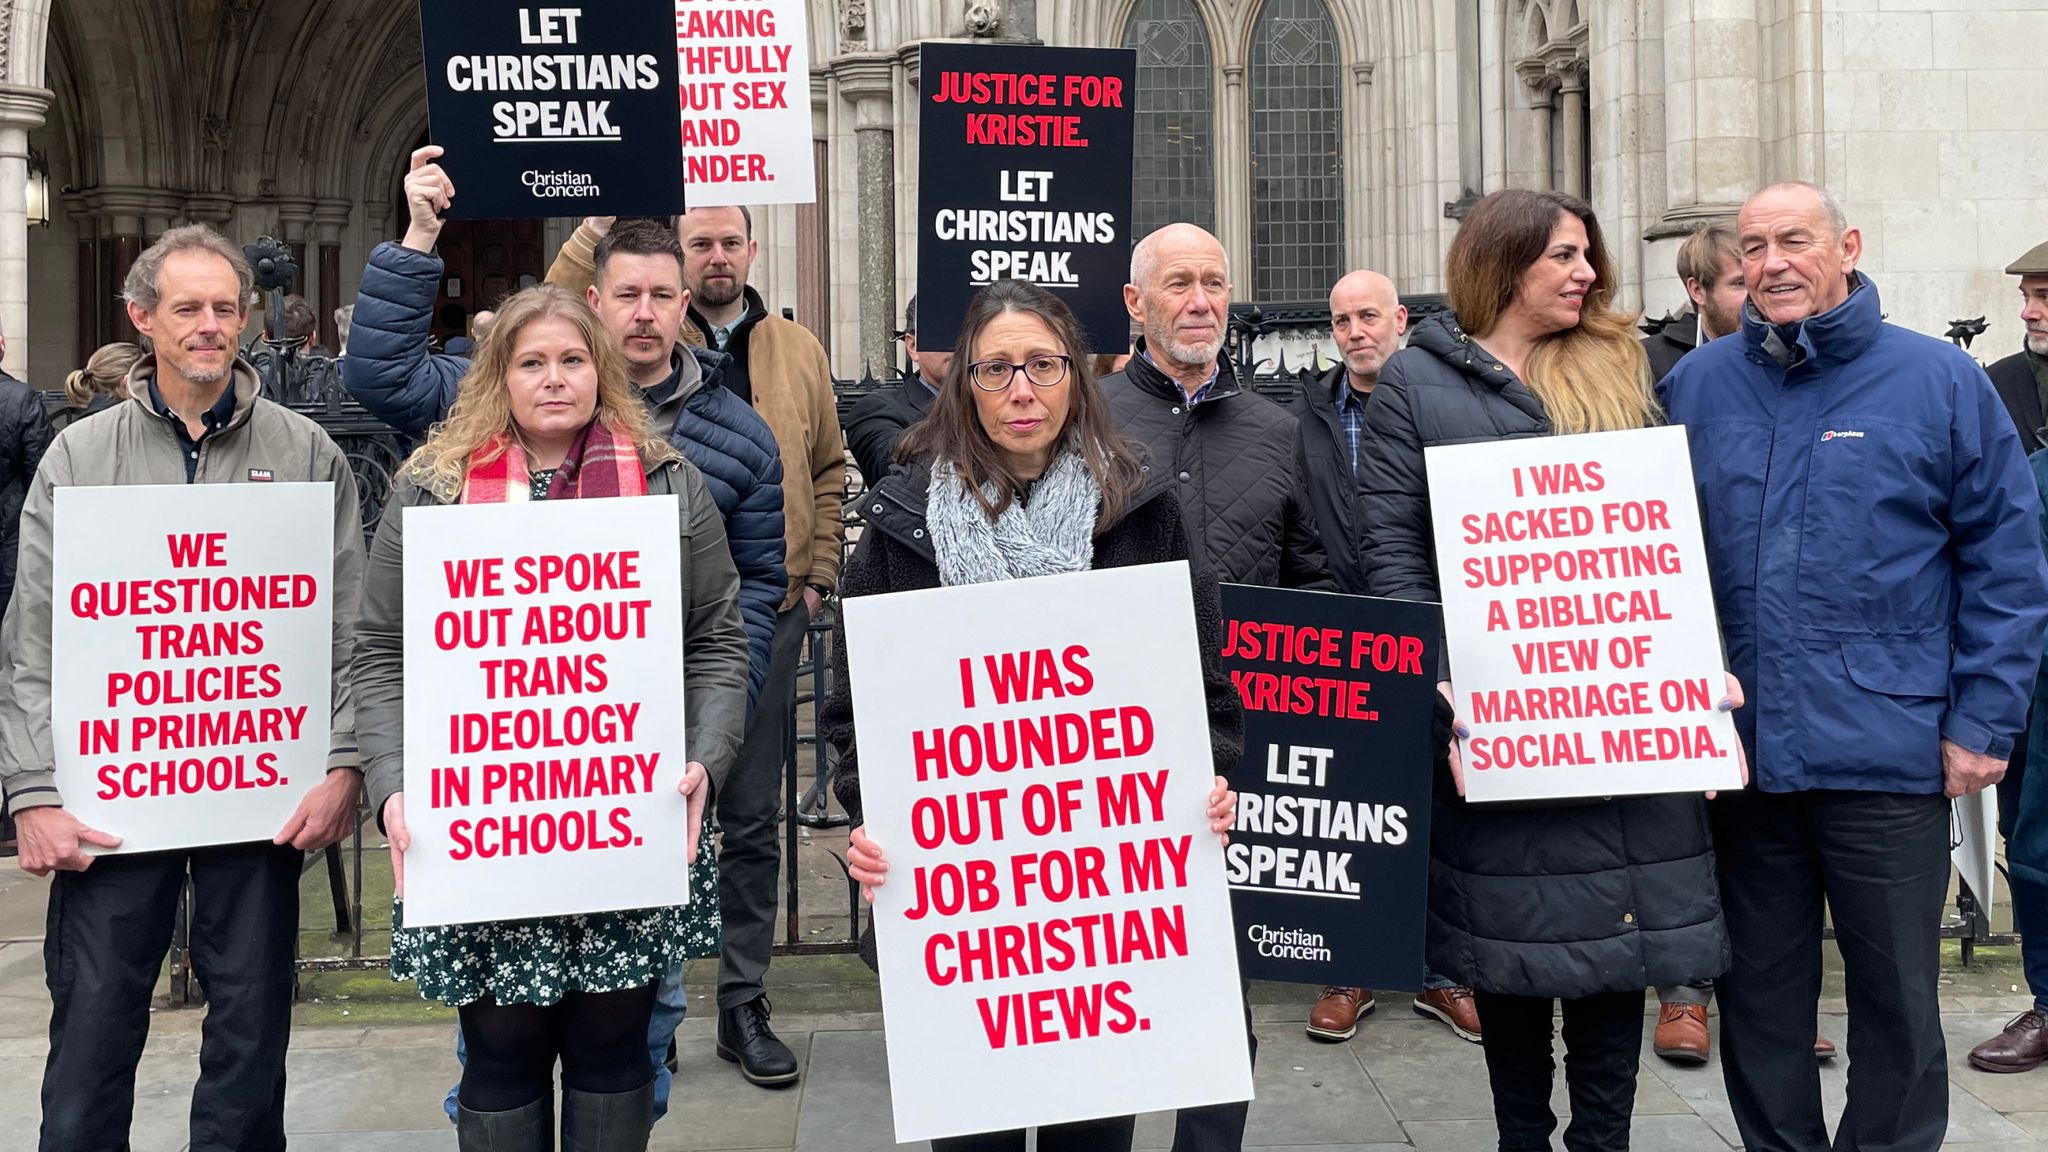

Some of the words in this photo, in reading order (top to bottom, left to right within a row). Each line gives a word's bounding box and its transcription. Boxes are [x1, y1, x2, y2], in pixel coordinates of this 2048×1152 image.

[519, 9, 581, 43] LET
[447, 55, 659, 91] CHRISTIANS
[933, 72, 1056, 105] JUSTICE
[1064, 76, 1122, 107] FOR
[733, 82, 786, 110] SEX
[492, 100, 621, 137] SPEAK.
[682, 119, 740, 147] AND
[967, 113, 1088, 146] KRISTIE.
[521, 170, 592, 187] Christian
[532, 181, 600, 198] Concern
[684, 154, 774, 183] NDER.
[1000, 171, 1053, 202] LET
[936, 209, 1114, 243] CHRISTIANS
[969, 249, 1079, 283] SPEAK.
[1512, 469, 1522, 496] I
[1531, 462, 1604, 495] WAS
[1463, 507, 1593, 544] SACKED
[1603, 500, 1669, 532] FOR
[168, 533, 226, 568] WE
[1464, 544, 1680, 587] SUPPORTING
[444, 558, 504, 598] WE
[515, 551, 640, 595] SPOKE
[71, 575, 316, 620] QUESTIONED
[1488, 601, 1509, 630] A
[1517, 590, 1671, 628] BIBLICAL
[136, 621, 263, 659] TRANS
[435, 608, 512, 650] OUT
[523, 600, 651, 645] ABOUT
[1351, 632, 1423, 674] FOR
[1513, 640, 1598, 674] VIEW
[1609, 636, 1651, 668] OF
[108, 664, 281, 707] POLICIES
[480, 654, 608, 699] TRANS
[960, 658, 975, 708] I
[984, 645, 1093, 704] WAS
[1231, 670, 1378, 720] KRISTIE.
[1472, 683, 1652, 723] MARRIAGE
[1660, 679, 1710, 712] ON
[80, 719, 119, 755] IN
[132, 707, 306, 751] PRIMARY
[451, 703, 639, 754] IDEOLOGY
[912, 706, 1154, 781] HOUNDED
[1471, 733, 1594, 769] SOCIAL
[1602, 726, 1726, 762] MEDIA.
[98, 753, 288, 800] SCHOOLS.
[432, 767, 469, 808] IN
[483, 753, 659, 804] PRIMARY
[1267, 744, 1333, 786] LET
[912, 789, 1008, 849] OUT
[1022, 779, 1083, 836] OF
[1096, 770, 1168, 828] MY
[450, 808, 642, 860] SCHOOLS.
[904, 860, 999, 920] JOB
[1011, 847, 1109, 906] FOR
[1120, 835, 1192, 893] MY
[1227, 843, 1360, 893] SPEAK.
[925, 905, 1188, 986] CHRISTIAN
[1248, 924, 1324, 947] Christian
[1257, 938, 1331, 962] Concern
[976, 981, 1150, 1048] VIEWS.
